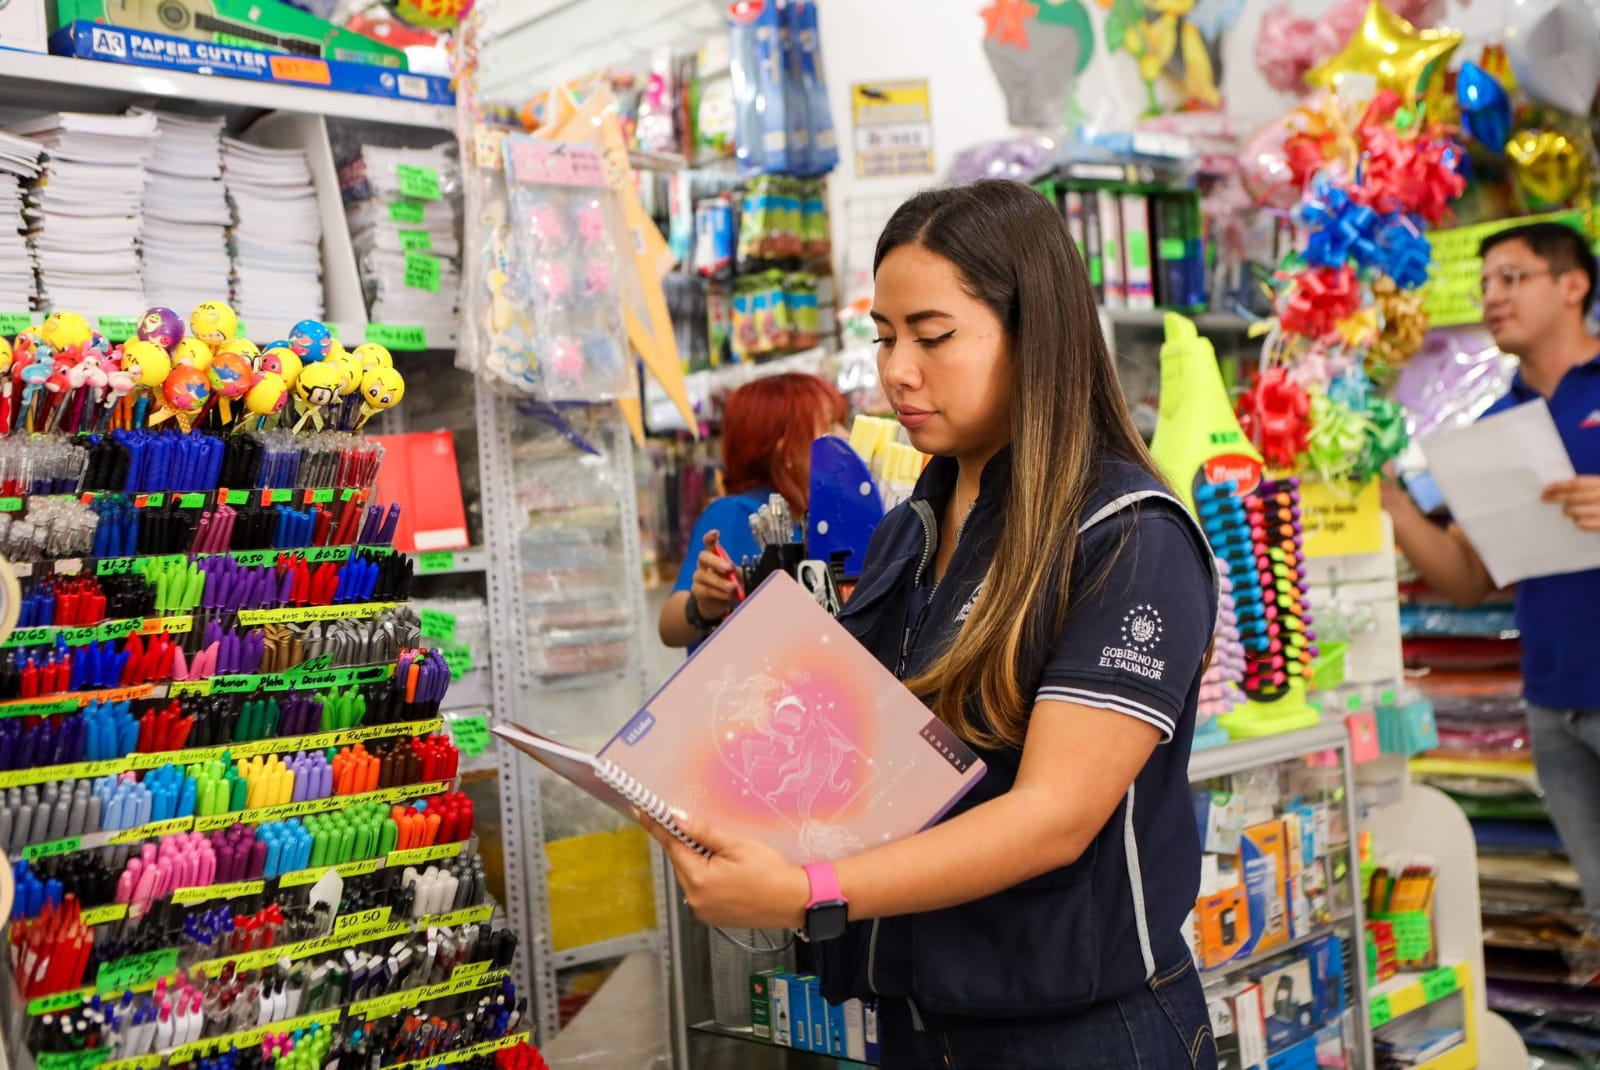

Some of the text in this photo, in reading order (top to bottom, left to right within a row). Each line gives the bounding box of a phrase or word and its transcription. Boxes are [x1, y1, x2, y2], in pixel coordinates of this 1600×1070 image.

[96, 32, 124, 54] A3
[130, 35, 190, 57] PAPER
[195, 44, 267, 68] CUTTER
[7, 630, 47, 643] $0.65
[104, 619, 142, 636] $0.65
[1099, 656, 1162, 680] EL SALVADOR
[1102, 646, 1165, 671] GOBIERNO DE
[213, 678, 248, 689] Plumon
[260, 677, 284, 688] Plata
[302, 674, 337, 685] Dorado
[340, 910, 381, 929] $0.50
